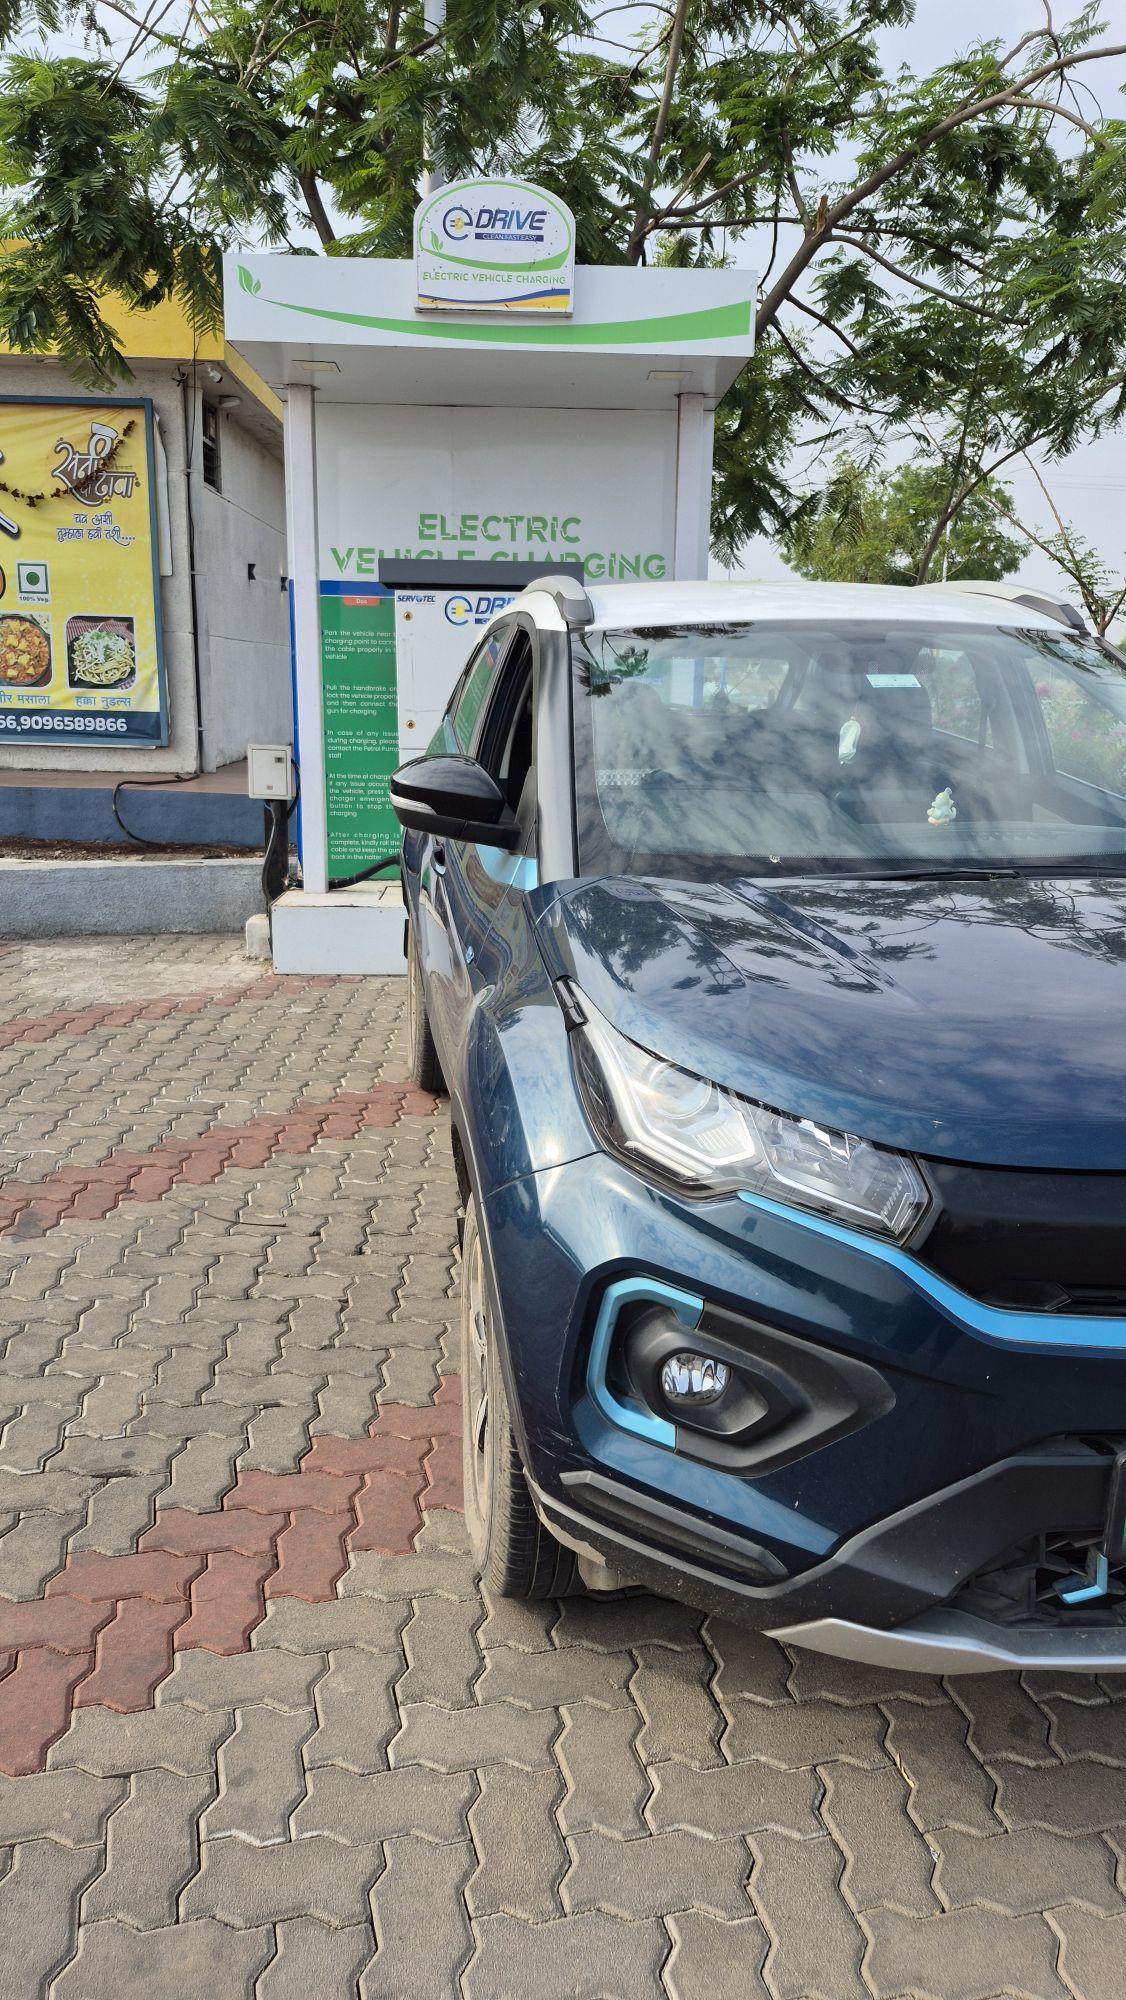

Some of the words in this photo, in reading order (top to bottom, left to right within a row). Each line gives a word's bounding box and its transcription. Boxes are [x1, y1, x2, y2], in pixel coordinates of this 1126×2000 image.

[476, 209, 547, 230] DRIVE
[423, 272, 468, 281] ELECTRIC
[473, 273, 512, 283] VEHICLE
[516, 274, 566, 284] CHARGING
[418, 513, 582, 543] ELECTRIC
[17, 694, 51, 705] मसाला
[75, 696, 96, 706] हक्का
